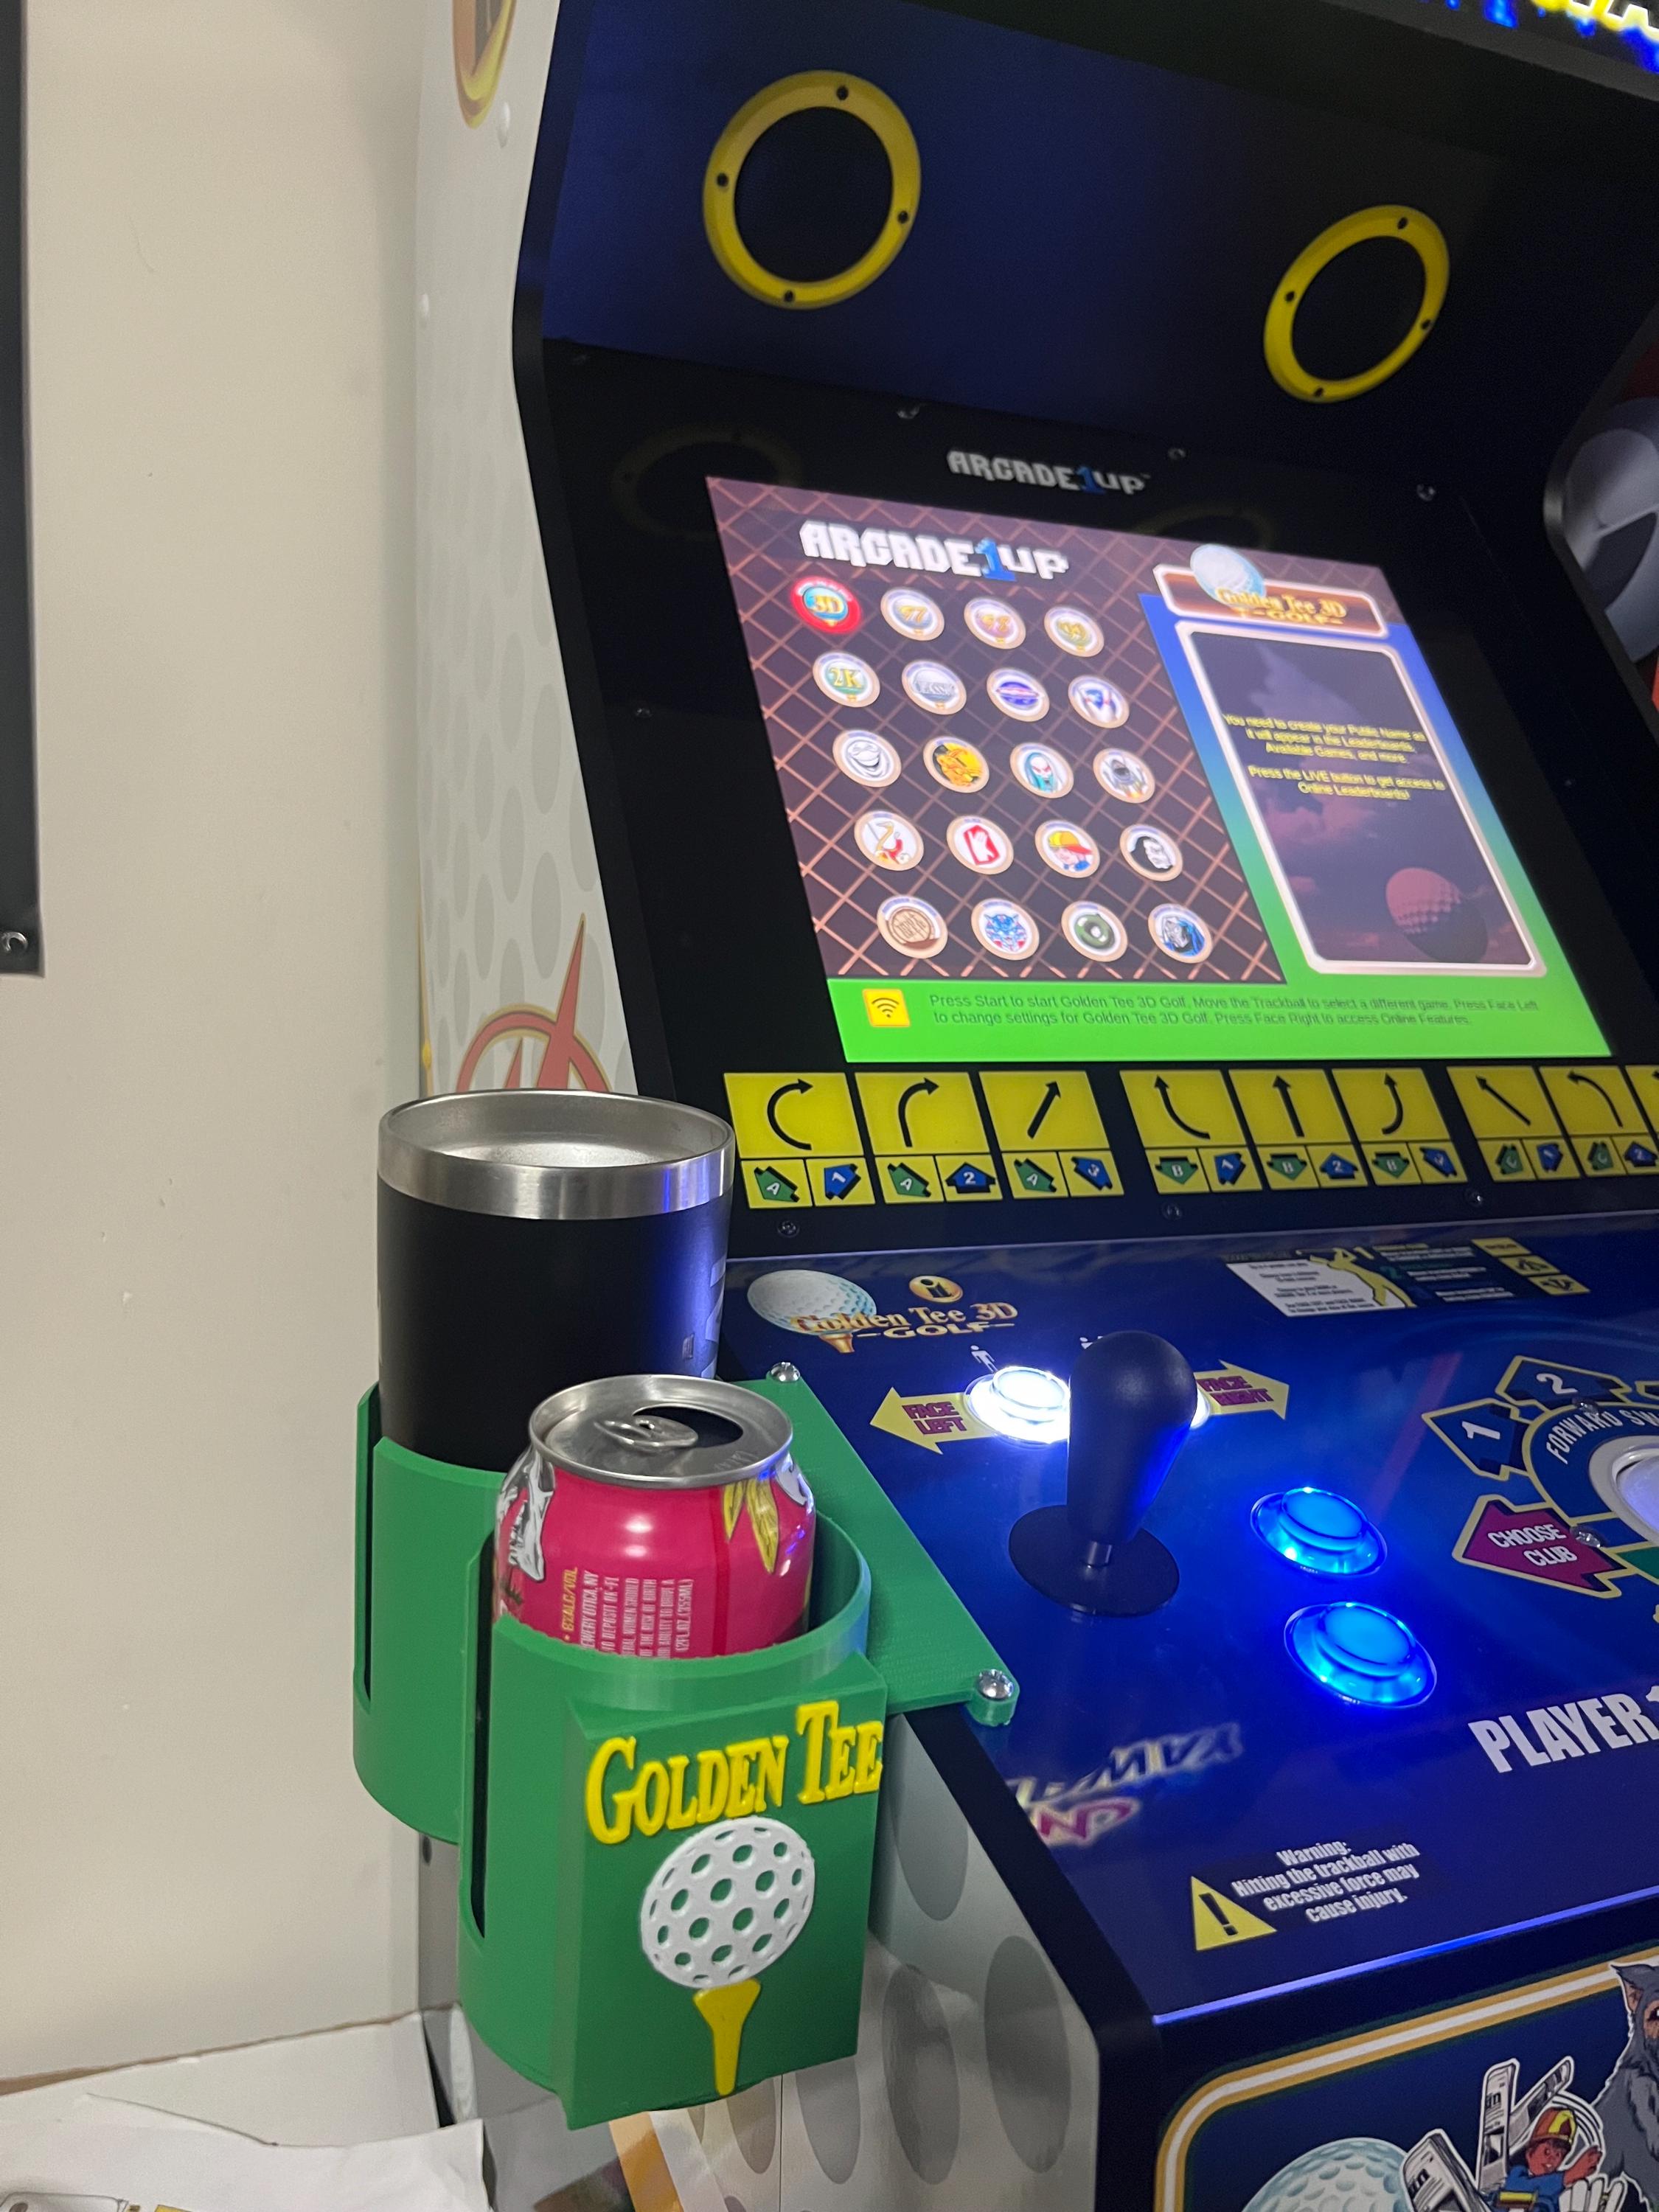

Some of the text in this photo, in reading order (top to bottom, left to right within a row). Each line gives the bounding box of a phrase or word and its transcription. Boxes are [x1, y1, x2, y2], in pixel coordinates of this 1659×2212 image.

[947, 450, 1146, 495] ARCADE1UP
[799, 519, 1069, 582] ARCADE1UP
[815, 594, 844, 613] 3D
[830, 667, 862, 689] 2K
[1224, 714, 1245, 726] You
[1274, 719, 1287, 729] to
[1248, 765, 1283, 779] Press
[1283, 768, 1302, 779] the
[1302, 770, 1330, 782] LIVE
[1330, 772, 1363, 784] button
[1364, 774, 1377, 785] to
[1298, 782, 1334, 795] Online
[930, 995, 971, 1007] Press
[975, 995, 1007, 1007] Start
[1010, 995, 1023, 1007] to
[1028, 995, 1058, 1008] start
[1060, 995, 1107, 1008] Golden
[1111, 996, 1135, 1008] Tee
[1139, 997, 1156, 1009] 3D
[1192, 997, 1228, 1009] Move
[1229, 997, 1250, 1009] the
[1253, 997, 1305, 1009] Trackball
[1307, 998, 1320, 1009] to
[1323, 998, 1357, 1009] select
[1360, 1001, 1368, 1010] a
[1370, 998, 1417, 1010] different
[1453, 998, 1486, 1010] Press
[1488, 999, 1516, 1011] Face
[1517, 999, 1539, 1011] Left
[933, 1012, 948, 1023] to
[951, 1012, 1002, 1026] change
[1006, 1012, 1057, 1026] settings
[1060, 1012, 1079, 1023] for
[1082, 1012, 1130, 1025] Golden
[1134, 1013, 1156, 1025] Tee
[1161, 1013, 1178, 1025] 3D
[1214, 1013, 1251, 1025] Press
[1253, 1013, 1285, 1025] Face
[1288, 1013, 1321, 1026] Right
[1321, 1014, 1334, 1025] to
[1338, 1014, 1378, 1025] access
[1381, 1013, 1417, 1025] Online
[1633, 1149, 1644, 1160] 2
[1087, 1164, 1101, 1177] 3
[1171, 1164, 1184, 1178] B
[1221, 1159, 1234, 1171] 1
[1281, 1161, 1295, 1173] B
[1332, 1160, 1343, 1172] 2
[1386, 1160, 1398, 1171] B
[830, 1171, 847, 1184] 1
[900, 1178, 914, 1192] A
[962, 1172, 977, 1186] 2
[1026, 1174, 1040, 1186] A
[765, 1181, 782, 1196] A
[790, 1302, 1018, 1333] Golden Tee 3D
[883, 1321, 990, 1339] GOLF
[1196, 1376, 1253, 1393] FACE
[1536, 1372, 1579, 1395] 2
[902, 1401, 960, 1420] FACE
[914, 1416, 967, 1436] LEFT
[1461, 1420, 1501, 1441] 1
[1545, 1410, 1624, 1465] FORWARD
[1488, 1523, 1568, 1548] CHOOSE
[1523, 1545, 1578, 1567] CLUB
[583, 1570, 599, 1586] NY
[625, 1578, 639, 1607] SHOULD
[642, 1579, 657, 1601] BIRTH
[602, 1604, 617, 1639] DEPOSIT
[622, 1607, 638, 1635] WOMEN
[641, 1614, 655, 1630] RISK
[659, 1608, 673, 1618] TO
[640, 1633, 654, 1646] THE
[1467, 1693, 1659, 1773] PLAYER
[585, 1734, 789, 1844] GOLDEN
[795, 1700, 883, 1805] TEE
[1276, 1840, 1352, 1867] Warning:
[1231, 1843, 1421, 1898] Hitting the trackball with
[1262, 1863, 1420, 1912] excessive force may
[1305, 1887, 1408, 1923] cause injury.
